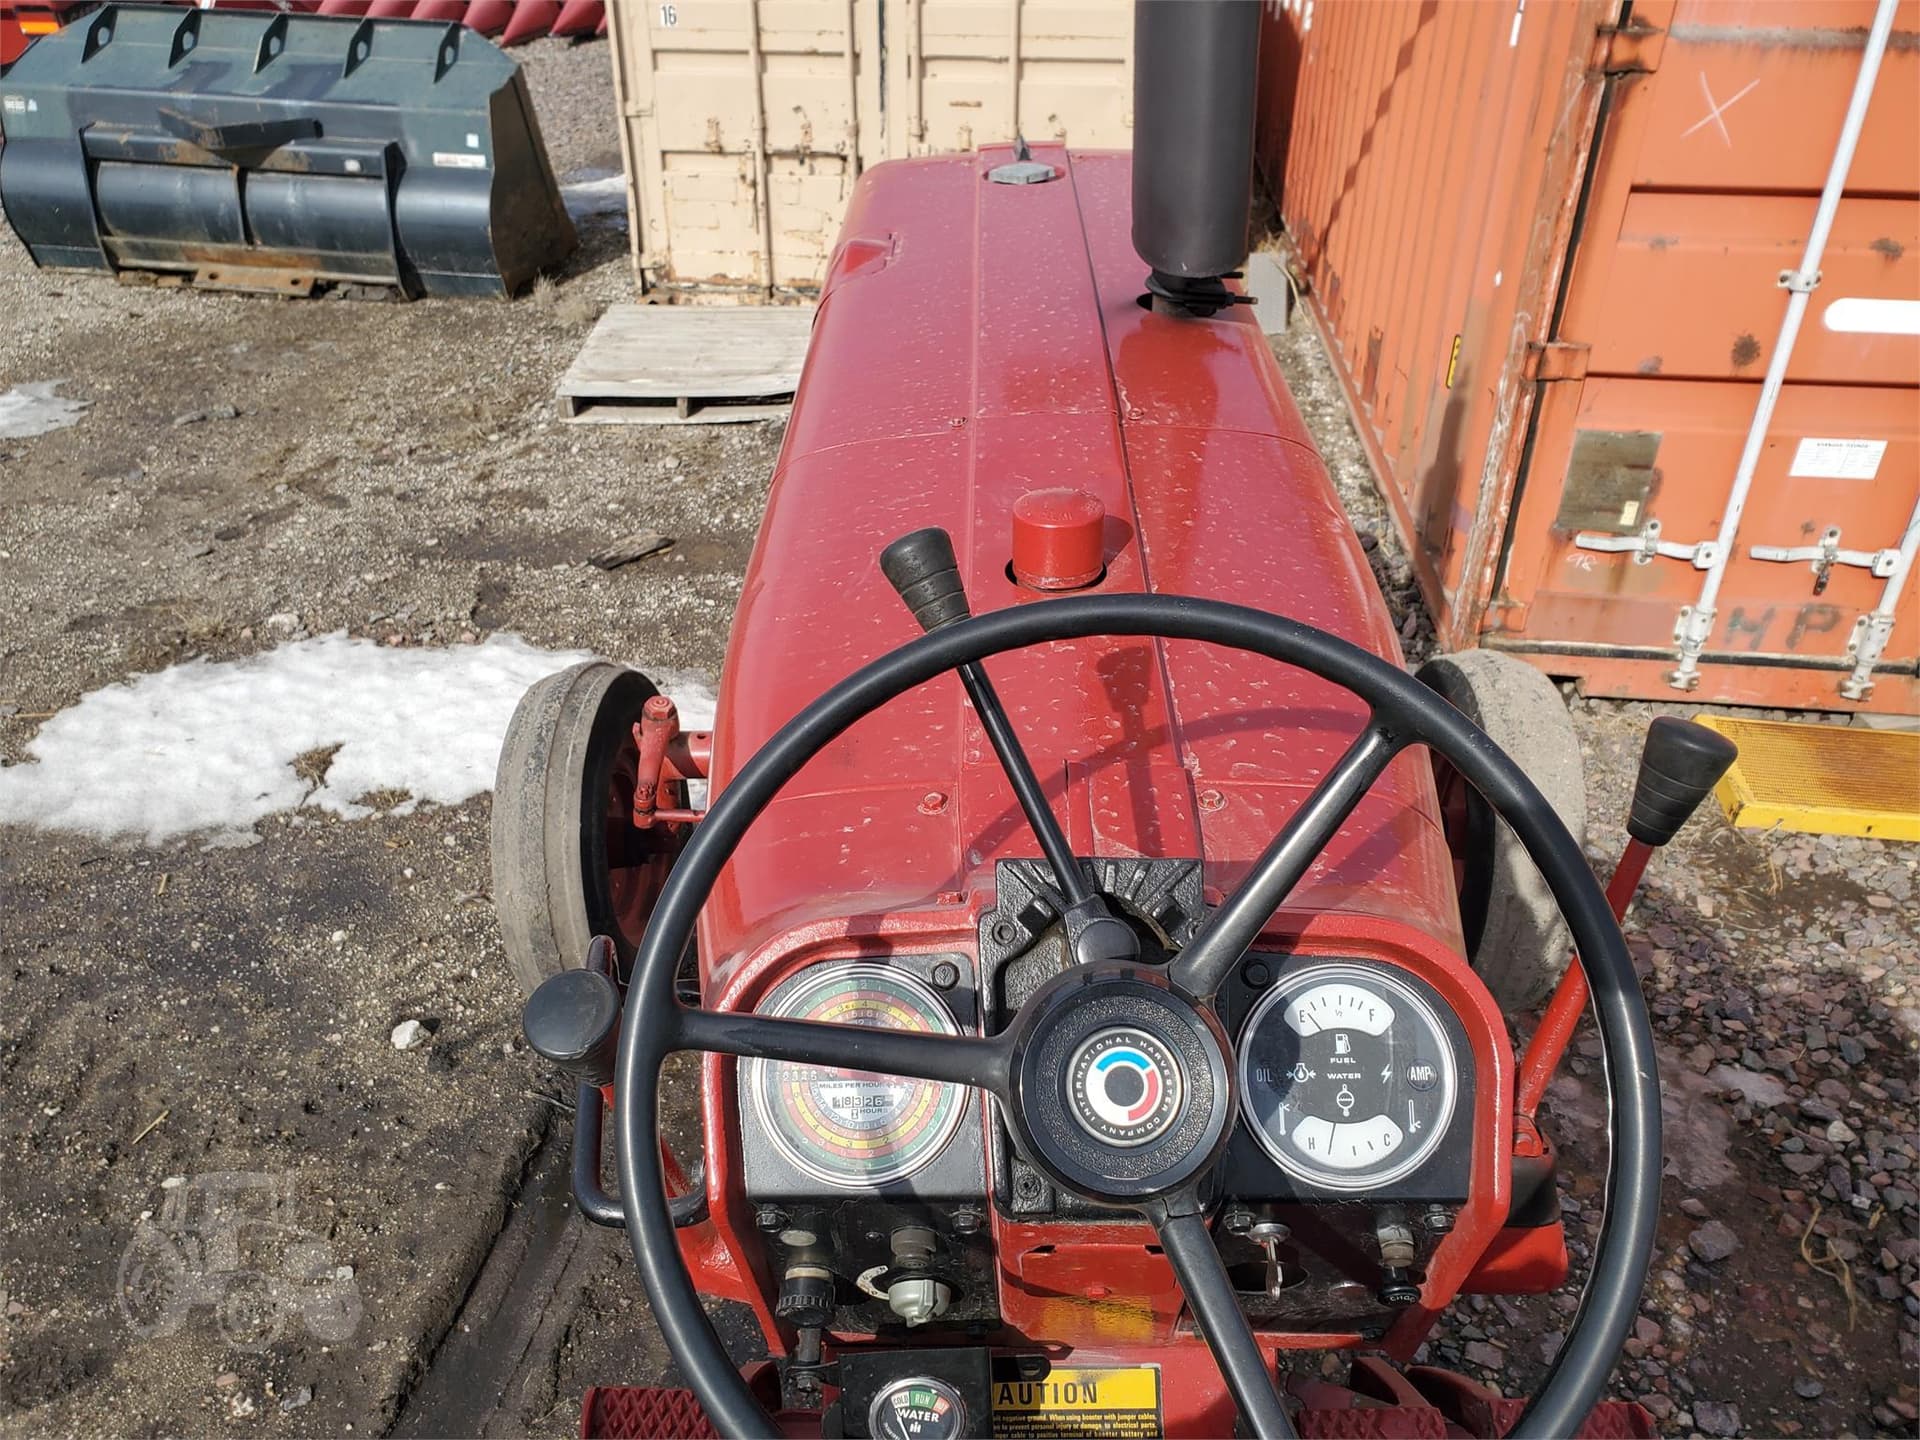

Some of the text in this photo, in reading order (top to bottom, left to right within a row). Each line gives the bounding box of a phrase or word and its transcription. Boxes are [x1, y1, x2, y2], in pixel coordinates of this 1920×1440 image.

[661, 4, 677, 25] 16
[1298, 1009, 1306, 1023] E
[1368, 1008, 1376, 1022] F
[1329, 1056, 1357, 1064] FUEL
[1256, 1067, 1274, 1083] OIL
[1326, 1071, 1362, 1080] WATER
[1409, 1065, 1431, 1082] AMP
[818, 1081, 844, 1089] MILES
[845, 1081, 861, 1089] PER
[1075, 1036, 1173, 1137] INTERNATIONAL HARVESTER COMPANY
[1307, 1133, 1391, 1150] H C
[892, 1395, 909, 1405] COLD
[914, 1393, 931, 1405] RUN
[997, 1381, 1099, 1406] AUTION
[896, 1407, 940, 1422] WATER
[1049, 1412, 1066, 1421] When
[1066, 1413, 1081, 1422] using
[1082, 1412, 1103, 1421] booster
[1104, 1412, 1117, 1421] with
[1117, 1412, 1137, 1421] jumper
[1138, 1412, 1158, 1420] cables.
[1031, 1423, 1055, 1431] personal
[1056, 1423, 1072, 1431] injury
[1112, 1421, 1139, 1429] electrical
[1140, 1422, 1157, 1430] parts.
